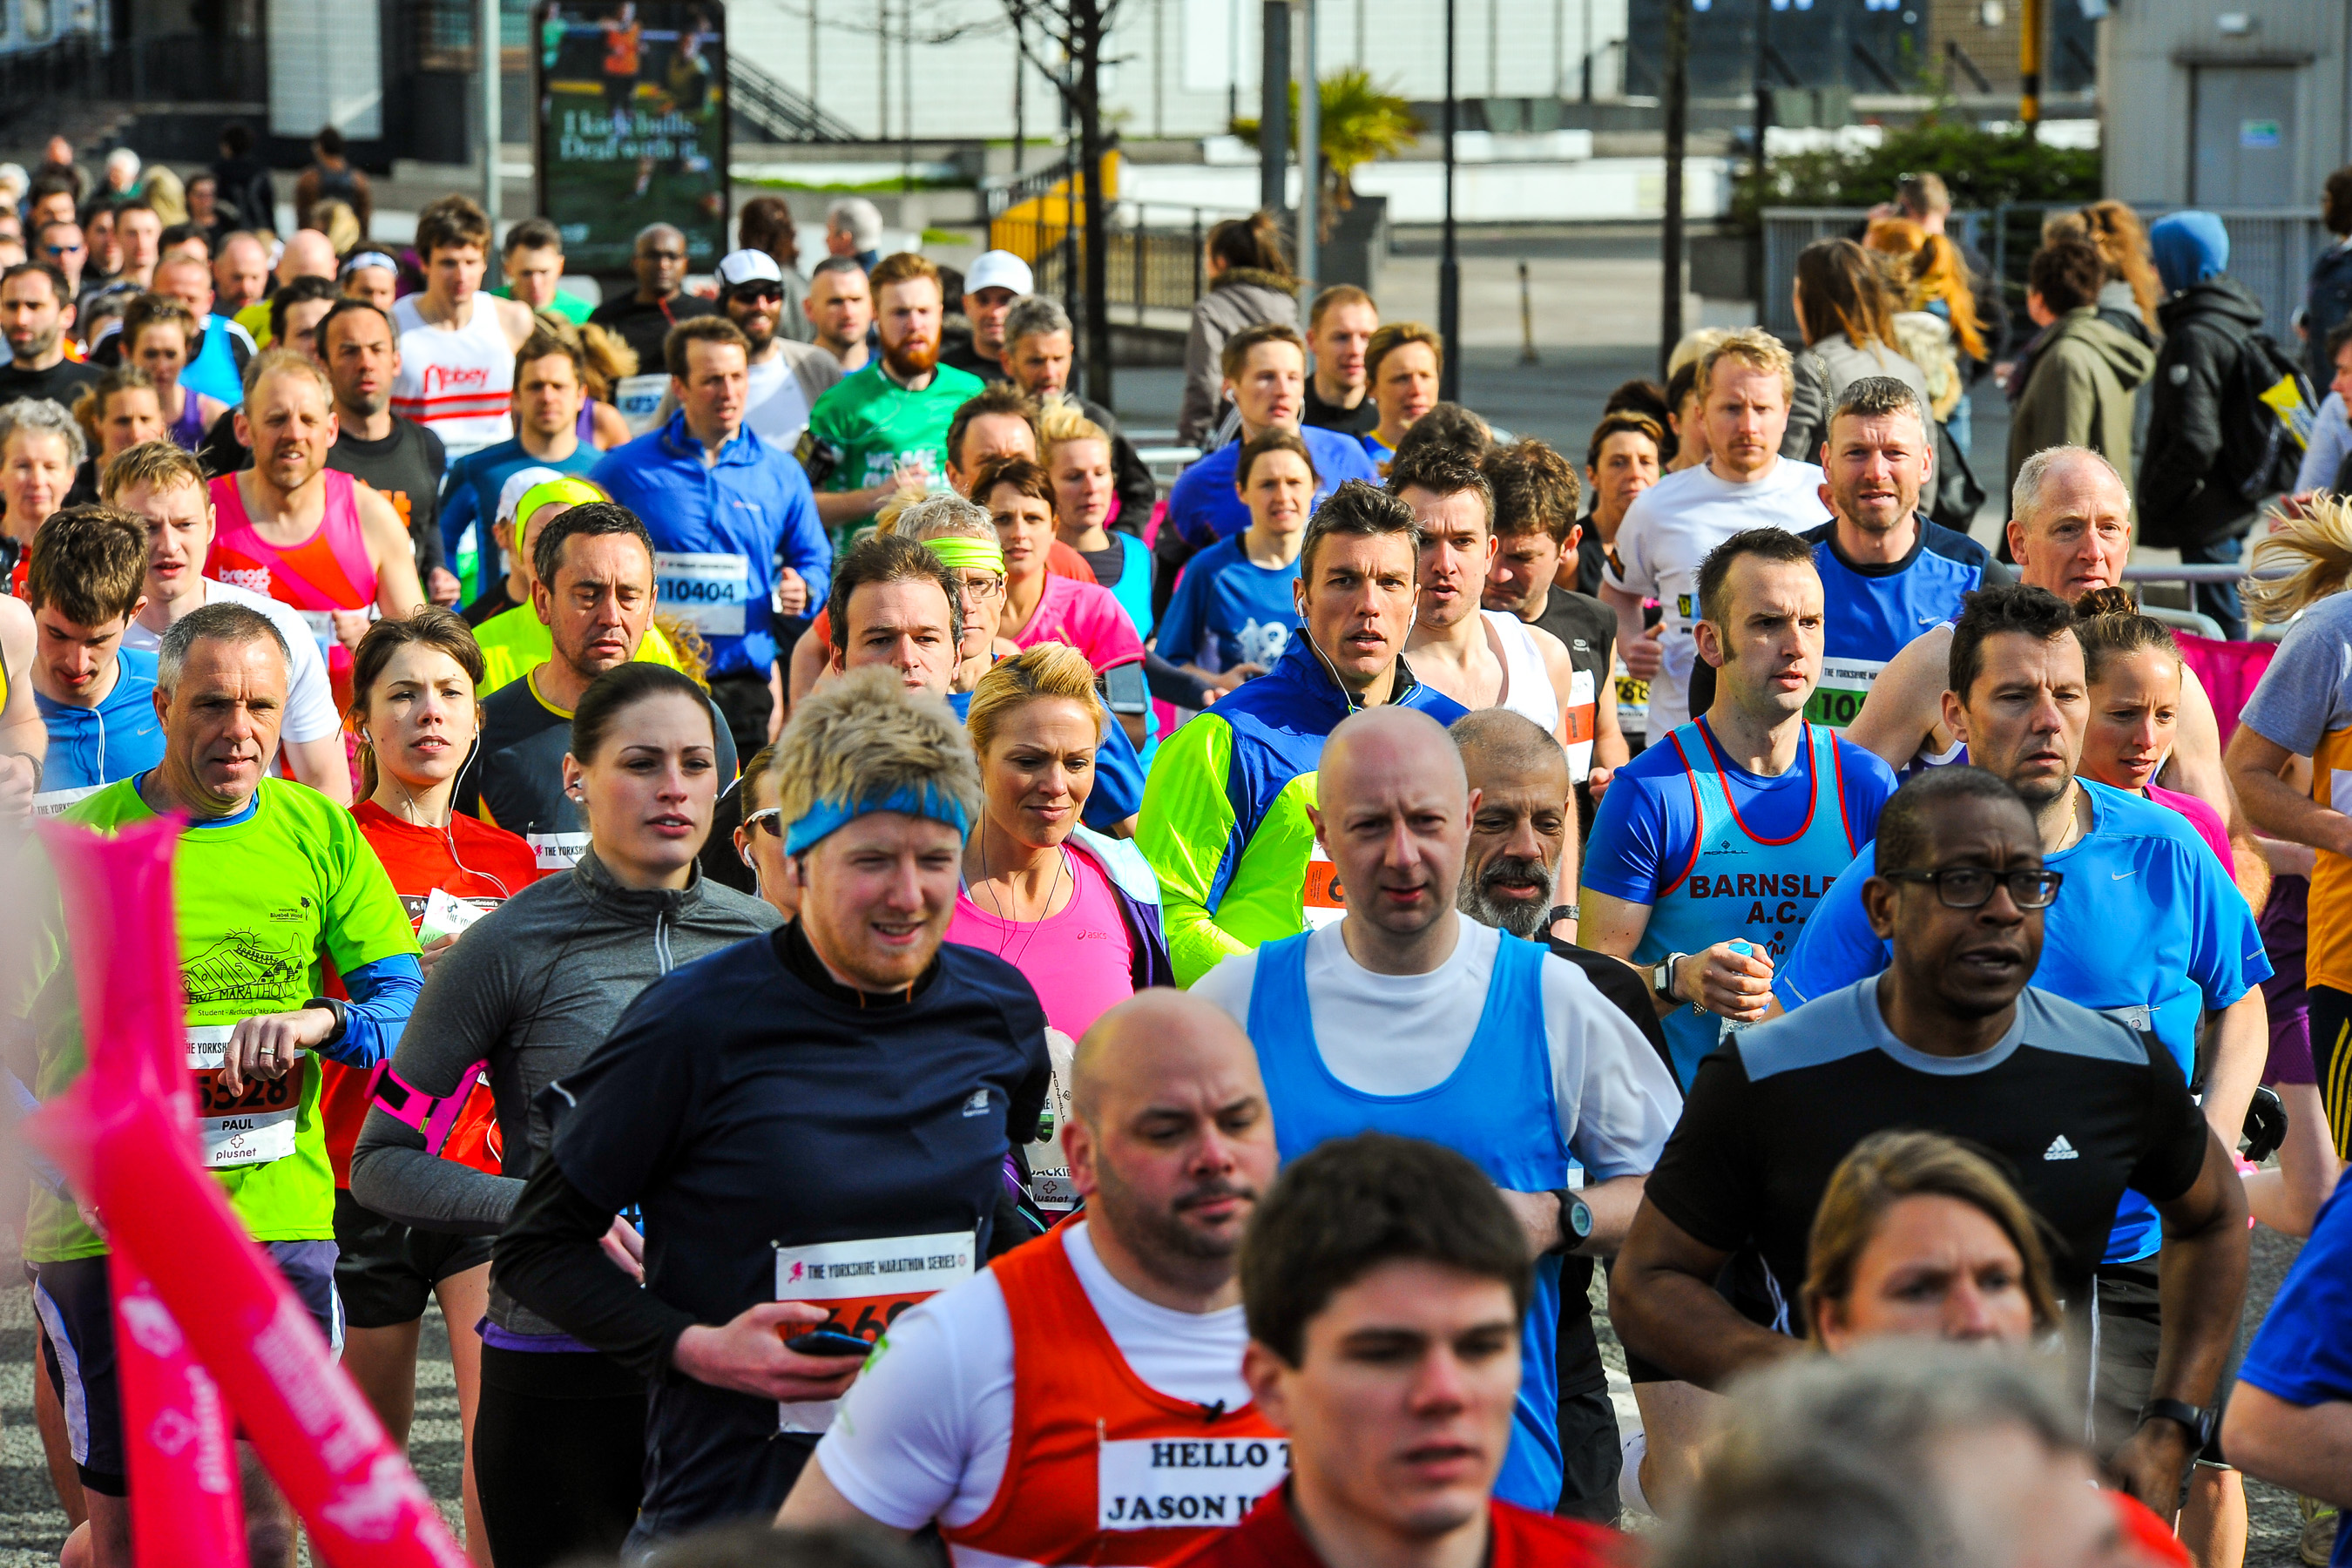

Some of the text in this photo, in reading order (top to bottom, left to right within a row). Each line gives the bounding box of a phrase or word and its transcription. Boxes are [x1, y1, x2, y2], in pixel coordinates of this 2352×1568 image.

[667, 580, 733, 601] 10404
[1821, 693, 1867, 723] 10
[37, 805, 50, 815] THE
[544, 845, 587, 856] THE YORKSHI
[446, 912, 458, 923] THE
[1746, 901, 1806, 924] A.C.
[1088, 931, 1107, 940] asics
[220, 983, 287, 1000] MARATHON
[197, 1042, 228, 1054] YORKSH
[221, 1119, 254, 1132] PAUL
[216, 1147, 257, 1161] plusnet
[1034, 1193, 1069, 1203] lusnet
[808, 1254, 956, 1280] THE YORKSHIRE MARATHON SERIES
[1152, 1442, 1269, 1468] HELLO
[1107, 1496, 1227, 1521] JASON
